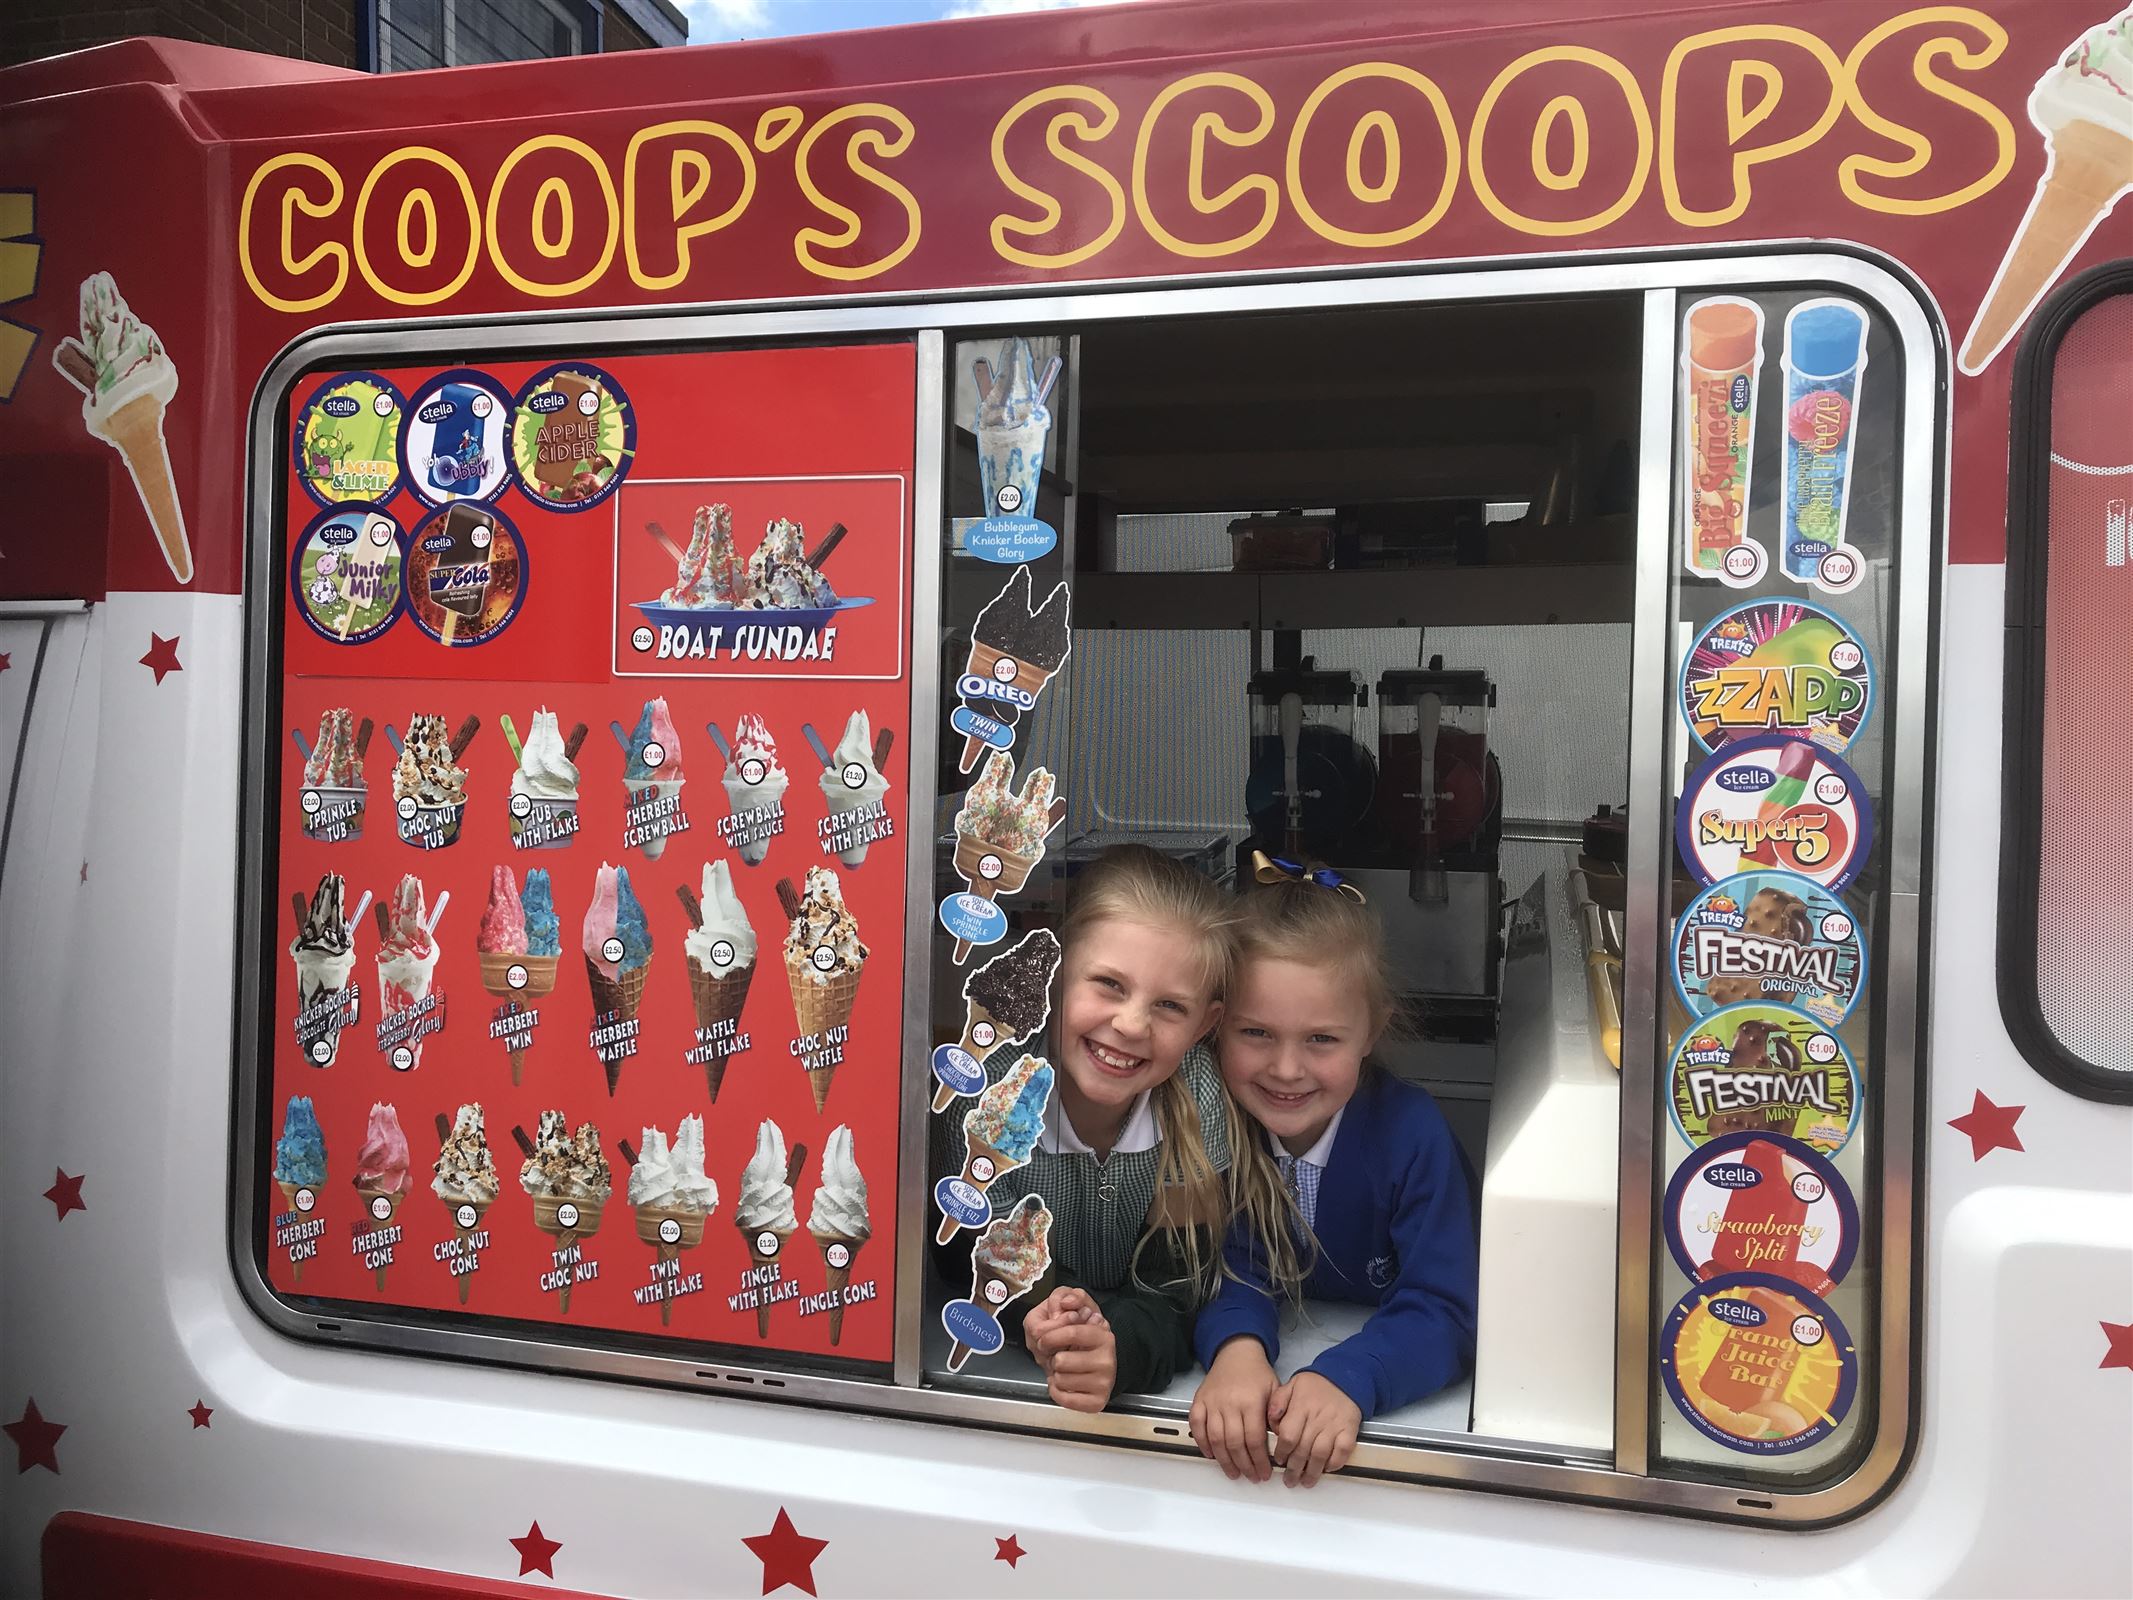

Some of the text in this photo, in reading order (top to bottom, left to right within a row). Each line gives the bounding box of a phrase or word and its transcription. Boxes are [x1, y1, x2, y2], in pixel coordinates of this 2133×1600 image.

[238, 102, 922, 313] COOP'S
[990, 6, 2017, 270] SCOOPS
[533, 395, 564, 408] stella
[1734, 379, 1744, 409] stella
[327, 400, 356, 411] stella
[376, 401, 392, 409] £1.00
[423, 403, 453, 420] stella
[473, 402, 491, 411] £1.00
[580, 400, 598, 408] £1.00
[535, 420, 600, 445] APPLE
[1731, 414, 1739, 453] ORANGE
[1813, 398, 1842, 471] Freeze
[537, 440, 599, 464] CIDER
[333, 460, 389, 475] LAGER
[1699, 378, 1743, 553] Big Squeezi
[332, 474, 389, 490] &LIME
[1000, 493, 1018, 502] £2.00
[1809, 477, 1834, 526] Brain
[324, 528, 353, 539] stella
[373, 530, 389, 538] £1.00
[472, 533, 489, 541] £1.00
[984, 521, 1038, 534] Bubblegum
[425, 538, 452, 549] stella
[972, 534, 1011, 546] Knicker
[1795, 543, 1827, 553] stella
[997, 547, 1025, 560] Glory
[1729, 558, 1753, 567] £1.00
[338, 560, 394, 579] Junior
[429, 566, 490, 586] SUPER Cola
[1825, 563, 1850, 574] £1.00
[349, 578, 398, 604] Milky
[634, 634, 651, 644] £2.50
[656, 625, 837, 662] BOAT SUNDAE
[1710, 635, 1755, 655] TREATS
[1833, 651, 1859, 663] £1.00
[996, 665, 1015, 675] £2.00
[960, 676, 1033, 706] OREO
[969, 713, 1000, 734] TWIN
[969, 727, 992, 740] CONE
[644, 751, 663, 759] £1.00
[744, 768, 763, 777] £1.00
[845, 771, 863, 780] £1.20
[1723, 770, 1770, 785] stella
[1819, 785, 1844, 794] £1.00
[303, 798, 319, 806] £2.00
[400, 803, 415, 812] £2.00
[513, 801, 529, 810] £2.00
[626, 795, 680, 827] SHERBERT
[309, 799, 357, 830] SPRINKLE
[401, 807, 457, 838] CHOC NUT
[530, 804, 552, 825] TUB
[717, 801, 785, 837] SCREWBALL
[817, 801, 887, 837] SCREWBALL
[327, 822, 347, 842] TUB
[424, 830, 445, 850] TUB
[513, 815, 579, 850] WITH FLAKE
[624, 813, 689, 848] SCREWBALL
[726, 819, 784, 848] WITH SAUCE
[821, 819, 894, 855] WITH FLAKE
[981, 863, 1000, 871] £2.00
[960, 899, 993, 916] ICE CREAM
[952, 917, 988, 936] SPRINKLE
[963, 914, 982, 926] TWIN
[1700, 911, 1744, 928] TREATS
[1824, 922, 1850, 933] £1.00
[957, 927, 978, 940] CONE
[605, 946, 622, 955] £2.50
[714, 950, 731, 958] £2.50
[816, 954, 834, 962] £2.50
[1697, 929, 1844, 994] FESTIVAL
[509, 972, 526, 981] £2.00
[1760, 978, 1818, 997] ORIGINAL
[294, 1003, 323, 1031] KNICKER
[376, 1010, 407, 1038] KNICKER
[490, 1009, 538, 1039] SHERBERT
[590, 1019, 639, 1048] SHERBERT
[695, 1018, 736, 1043] WAFFLE
[974, 1030, 993, 1038] £1.00
[504, 1030, 532, 1052] TWIN
[596, 1038, 637, 1063] WAFFLE
[685, 1032, 750, 1065] WITH FLAKE
[790, 1025, 848, 1057] CHOC NUT
[1809, 1043, 1835, 1053] £1.00
[801, 1046, 843, 1071] WAFFLE
[1686, 1050, 1731, 1064] TREATS
[1686, 1068, 1842, 1118] FESTIVAL
[1766, 1107, 1799, 1122] MINT
[973, 1163, 992, 1176] £1.00
[1711, 1168, 1756, 1182] stella
[951, 1184, 981, 1208] ICE CREAM
[1795, 1182, 1820, 1194] £1.00
[560, 1211, 576, 1219] £2.00
[941, 1192, 980, 1223] SPRINKLE FIZZ
[275, 1211, 297, 1227] BLUE
[276, 1219, 325, 1247] SHERBERT
[661, 1227, 678, 1235] £2.00
[1697, 1211, 1825, 1247] Strawberry
[352, 1226, 402, 1254] SHERBERT
[433, 1231, 489, 1261] CHOC NUT
[759, 1239, 776, 1248] £1.20
[289, 1240, 317, 1262] CONE
[365, 1248, 393, 1270] CONE
[552, 1245, 582, 1268] TWIN
[829, 1251, 848, 1260] £1.00
[1735, 1237, 1788, 1268] Split
[450, 1254, 479, 1277] CONE
[649, 1258, 680, 1282] TWIN
[540, 1261, 598, 1291] CHOC NUT
[741, 1264, 781, 1289] SINGLE
[633, 1273, 702, 1305] WITH FLAKE
[728, 1280, 799, 1312] WITH FLAKE
[799, 1281, 876, 1316] SINGLE CONE
[986, 1286, 1006, 1298] £1.00
[1715, 1303, 1760, 1322] stella
[949, 1307, 997, 1345] Birdsnest
[1795, 1324, 1820, 1336] £1.00
[1721, 1342, 1795, 1371] Juice
[1729, 1364, 1783, 1389] Bar
